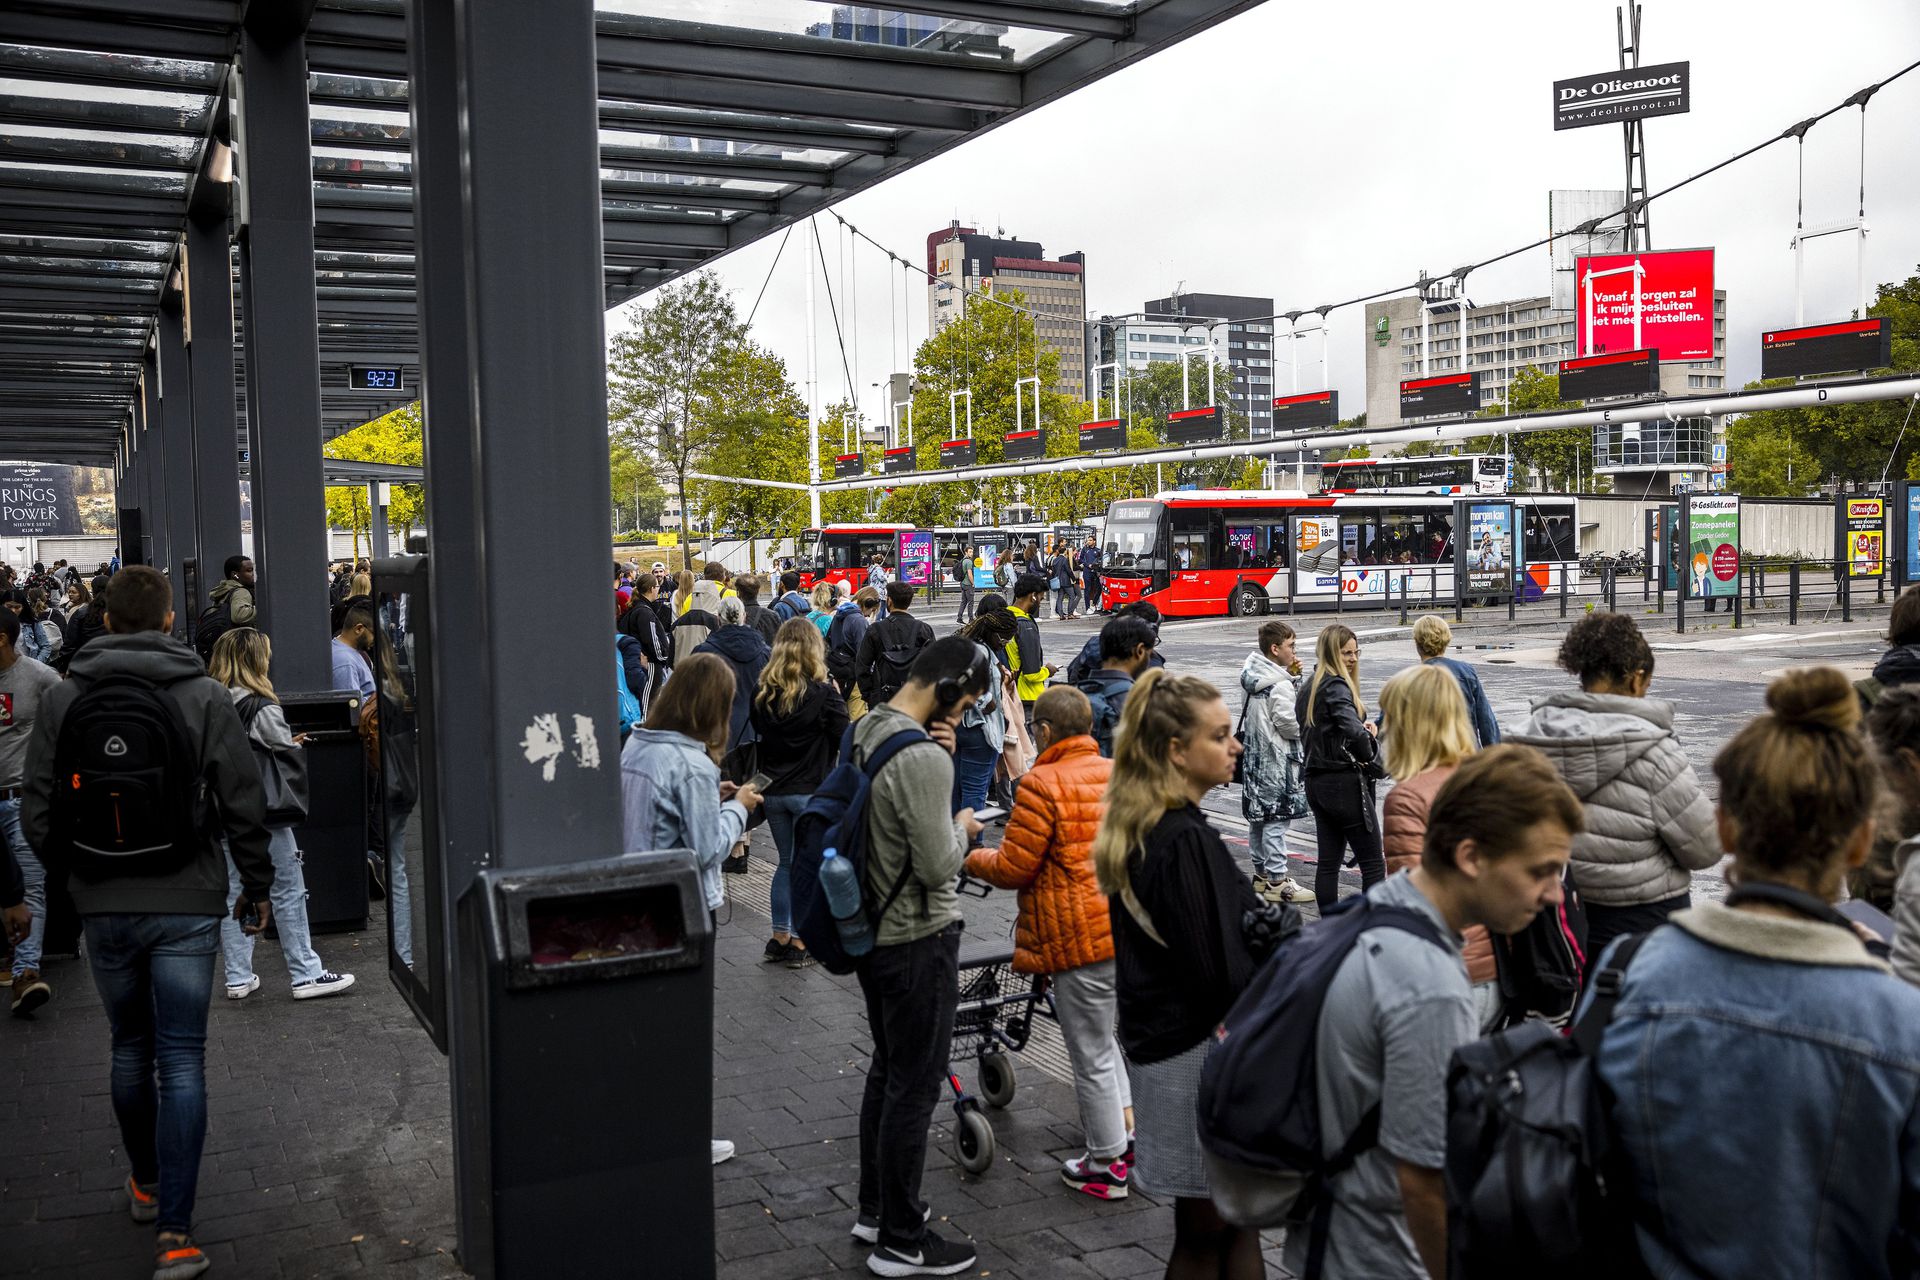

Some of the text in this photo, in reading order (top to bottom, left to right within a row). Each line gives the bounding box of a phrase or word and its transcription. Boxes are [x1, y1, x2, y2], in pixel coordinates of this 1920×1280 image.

[1560, 74, 1681, 101] De Olienoot
[1559, 98, 1681, 122] www.deolienoot.nl
[1594, 291, 1628, 303] Vanaf
[1679, 287, 1697, 298] zal
[1597, 301, 1693, 316] ik mijn besluiten
[1593, 316, 1609, 326] iet
[1646, 312, 1704, 324] uitstellen.
[1768, 334, 1774, 342] D
[1818, 390, 1827, 401] D
[1604, 410, 1610, 421] E
[1436, 427, 1442, 436] F
[1302, 440, 1308, 448] G
[1192, 450, 1198, 458] H
[2, 488, 57, 503] RINGS
[4, 506, 60, 520] POWER
[1304, 526, 1318, 534] 30%
[1692, 521, 1736, 530] Zonnepanelen
[902, 548, 929, 556] DEALS
